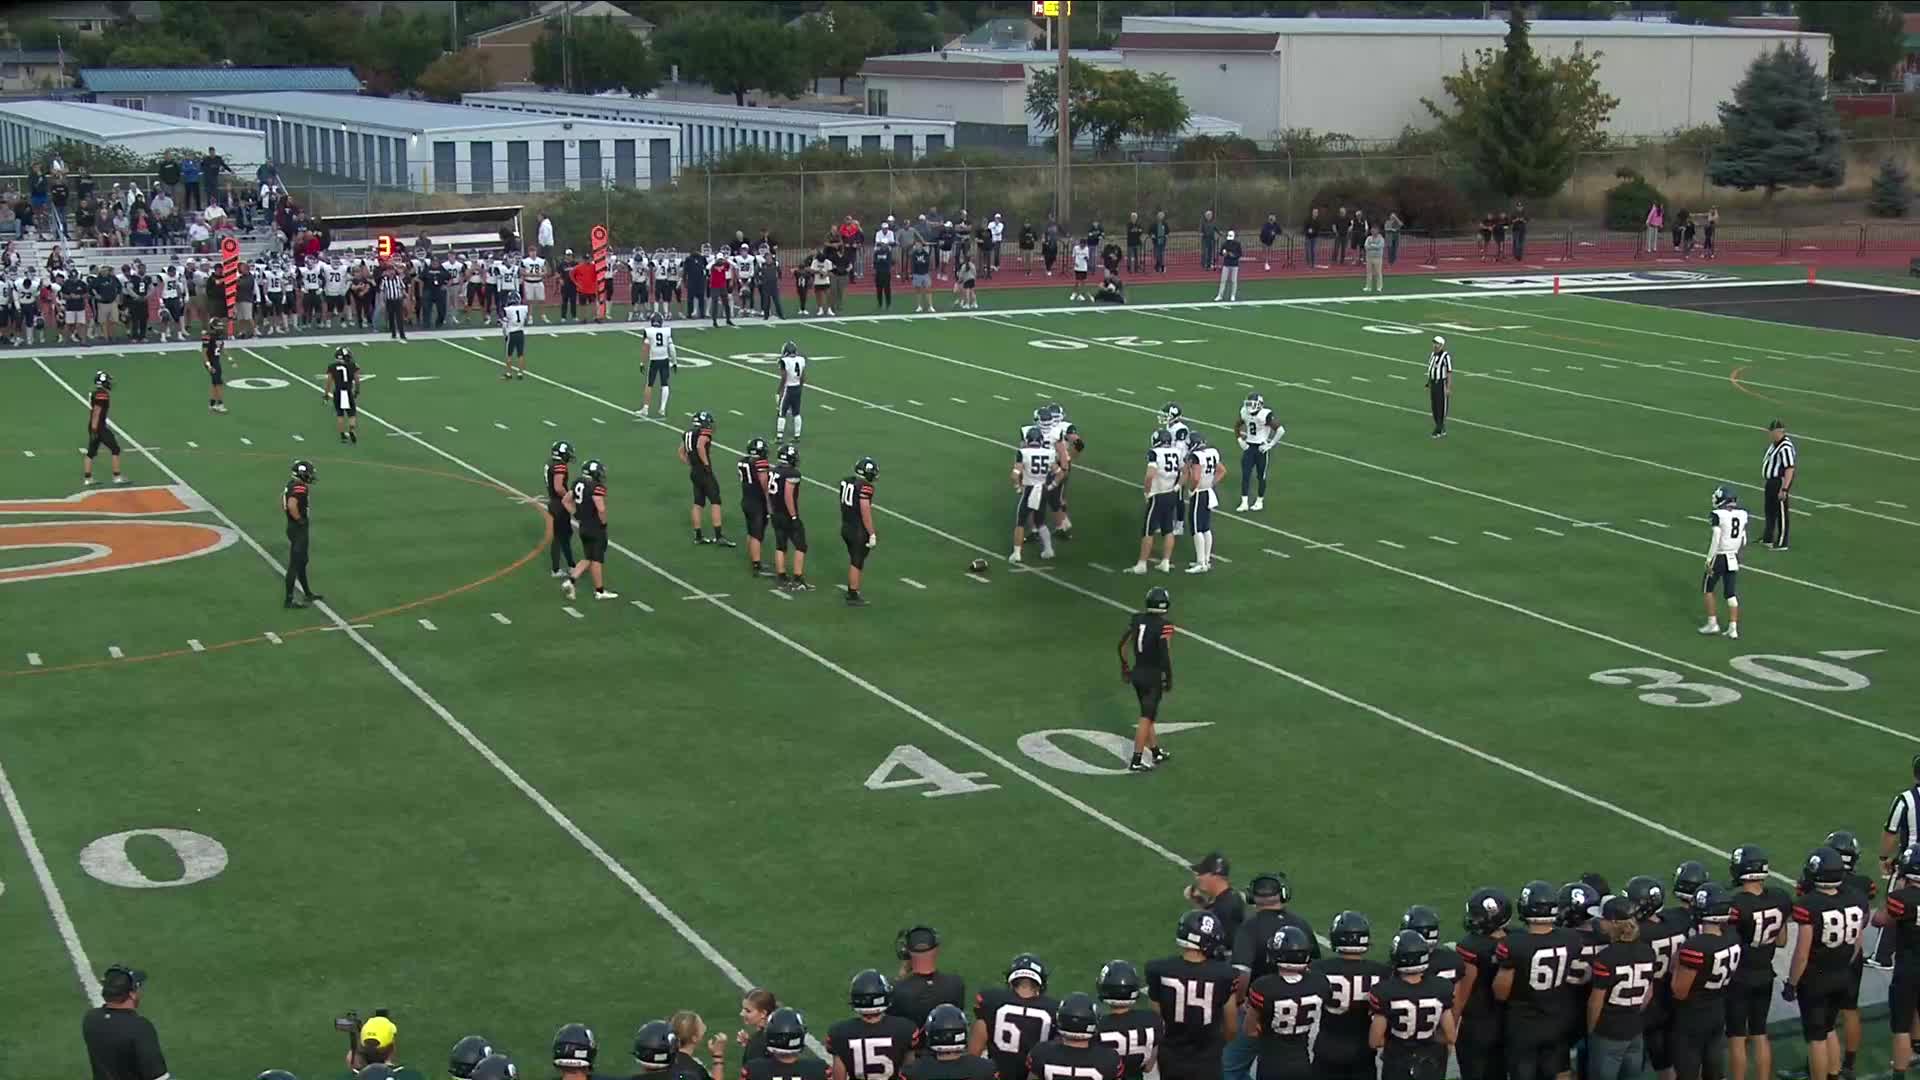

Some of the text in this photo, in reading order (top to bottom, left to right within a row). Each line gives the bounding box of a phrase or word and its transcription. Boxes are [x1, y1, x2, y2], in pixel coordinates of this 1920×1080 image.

[379, 235, 391, 256] 3
[139, 282, 146, 293] 2
[306, 273, 317, 284] 42
[330, 272, 341, 282] 70
[517, 310, 520, 322] 1
[655, 333, 663, 347] 9
[336, 366, 347, 382] 7
[795, 362, 801, 377] 4
[1249, 422, 1256, 435] 2
[685, 432, 694, 451] 11
[1031, 456, 1050, 474] 55
[1164, 453, 1179, 472] 53
[575, 482, 585, 504] 9
[1731, 517, 1740, 538] 8
[1138, 624, 1147, 653] 1
[1751, 908, 1783, 947] 12
[1821, 906, 1864, 948] 88
[1529, 946, 1568, 991] 61
[1608, 963, 1653, 1006] 25
[1160, 976, 1216, 1025] 74
[1271, 994, 1323, 1036] 83
[1391, 998, 1444, 1040] 33
[993, 1003, 1053, 1053] 67
[847, 1037, 895, 1080] 15
